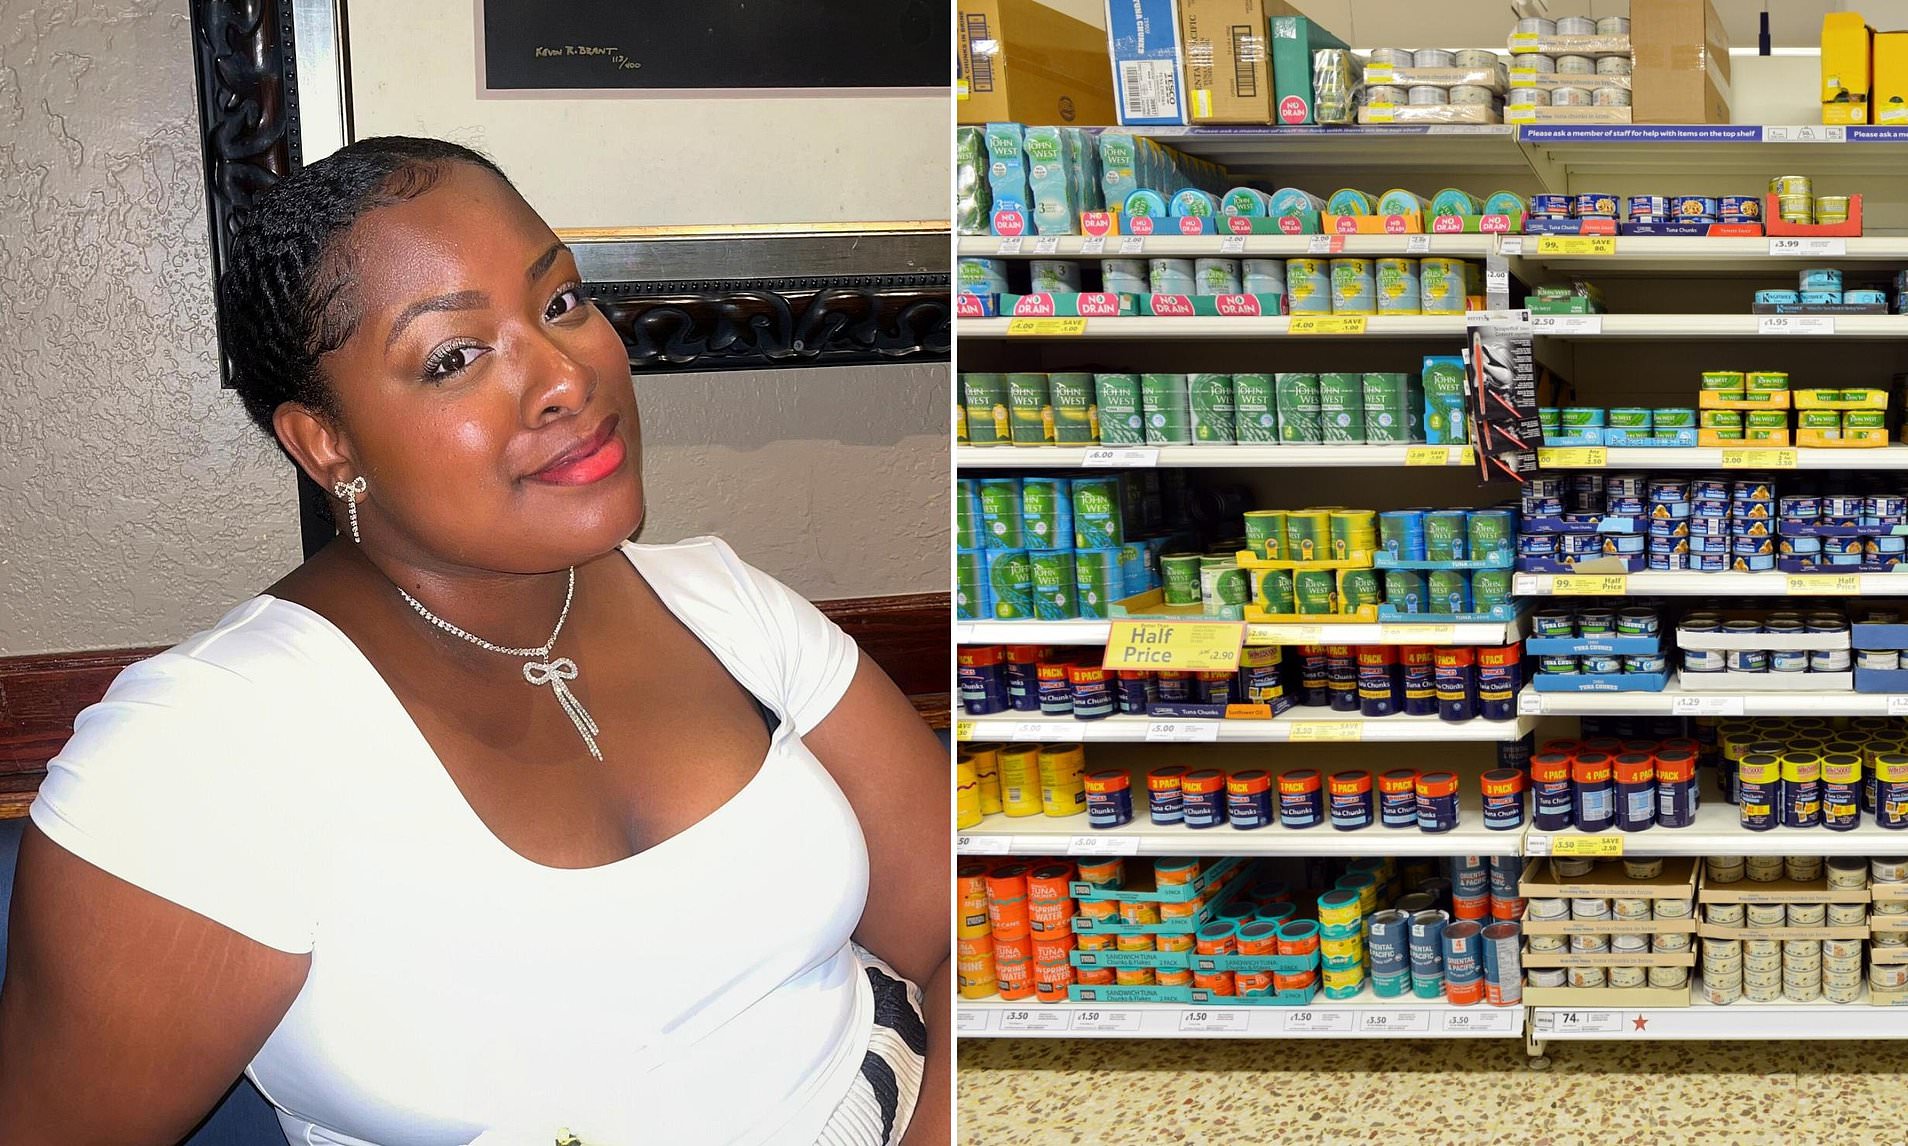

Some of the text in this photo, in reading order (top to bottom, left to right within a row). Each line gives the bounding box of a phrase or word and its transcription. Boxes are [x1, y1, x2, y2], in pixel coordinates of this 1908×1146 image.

[1166, 73, 1176, 105] TESCO
[1282, 109, 1305, 117] DRAIN
[1643, 130, 1659, 139] help
[1677, 130, 1697, 138] items
[1723, 131, 1735, 139] top
[1737, 130, 1756, 138] shelf
[990, 138, 1013, 148] JOHN
[1028, 141, 1051, 151] JOHN
[994, 148, 1018, 156] WEST
[1034, 150, 1057, 158] WEST
[1104, 147, 1127, 156] JOHN
[1108, 156, 1130, 164] WEST
[1039, 203, 1045, 214] 3
[1002, 214, 1014, 222] NO
[997, 221, 1022, 229] DRAIN
[1085, 219, 1109, 228] DRAIN
[1434, 223, 1460, 231] DRAIN
[1482, 222, 1506, 231] DRAIN
[1058, 265, 1066, 276] 3
[1106, 264, 1112, 273] 3
[1160, 262, 1166, 272] 3
[1227, 264, 1233, 273] 3
[1308, 263, 1314, 273] 3
[1356, 263, 1362, 273] 3
[1400, 262, 1406, 272] 3
[1827, 271, 1834, 281] K
[1024, 295, 1041, 304] NO
[1088, 295, 1105, 304] NO
[1160, 296, 1177, 304] NO
[1226, 296, 1244, 304] NO
[1875, 294, 1882, 303] K
[1018, 304, 1049, 313] DRAIN
[1082, 304, 1114, 313] DRAIN
[1156, 304, 1188, 313] DRAIN
[1222, 304, 1255, 313] DRAIN
[1433, 376, 1456, 385] JOHN
[1056, 386, 1081, 396] JOHN
[1104, 387, 1130, 396] JOHN
[1238, 386, 1262, 395] JOHN
[1014, 397, 1040, 405] WEST
[1060, 397, 1087, 405] WEST
[1108, 397, 1135, 405] WEST
[1241, 396, 1267, 404] WEST
[1082, 494, 1107, 504] JOHN
[1087, 504, 1111, 512] WEST
[1034, 567, 1056, 578] JOHN
[1038, 577, 1060, 585] WEST
[1131, 628, 1174, 644] Half
[1123, 646, 1172, 662] Price
[1363, 655, 1383, 664] PACK
[1043, 668, 1063, 677] PACK
[1367, 681, 1390, 689] Chunks
[1087, 697, 1112, 705] Chunks
[1549, 769, 1567, 779] PACK
[1661, 770, 1679, 780] PACK
[1159, 778, 1180, 788] PACK
[1230, 783, 1248, 792] PACK
[1284, 783, 1304, 792] PACK
[1392, 781, 1413, 790] PACK
[1493, 784, 1512, 793] PACK
[1188, 807, 1211, 815] Chunks
[1234, 808, 1257, 816] Chunks
[1289, 807, 1312, 815] Chunks
[1342, 808, 1366, 816] Chunks
[1465, 878, 1487, 886] PACIFIC
[1031, 886, 1057, 894] TUNA
[1036, 912, 1062, 920] WATER
[995, 947, 1020, 955] TUNA
[1039, 948, 1065, 956] TUNA
[1448, 956, 1474, 964] ORIENTAL
[1043, 973, 1070, 981] WATER
[1007, 1012, 1029, 1021] £3.50
[1078, 1012, 1099, 1021] £1.50
[1185, 1012, 1207, 1021] £1.50
[1290, 1012, 1312, 1021] £1.50
[1366, 1016, 1387, 1024] £3.50
[1449, 1016, 1469, 1024] £3.50
